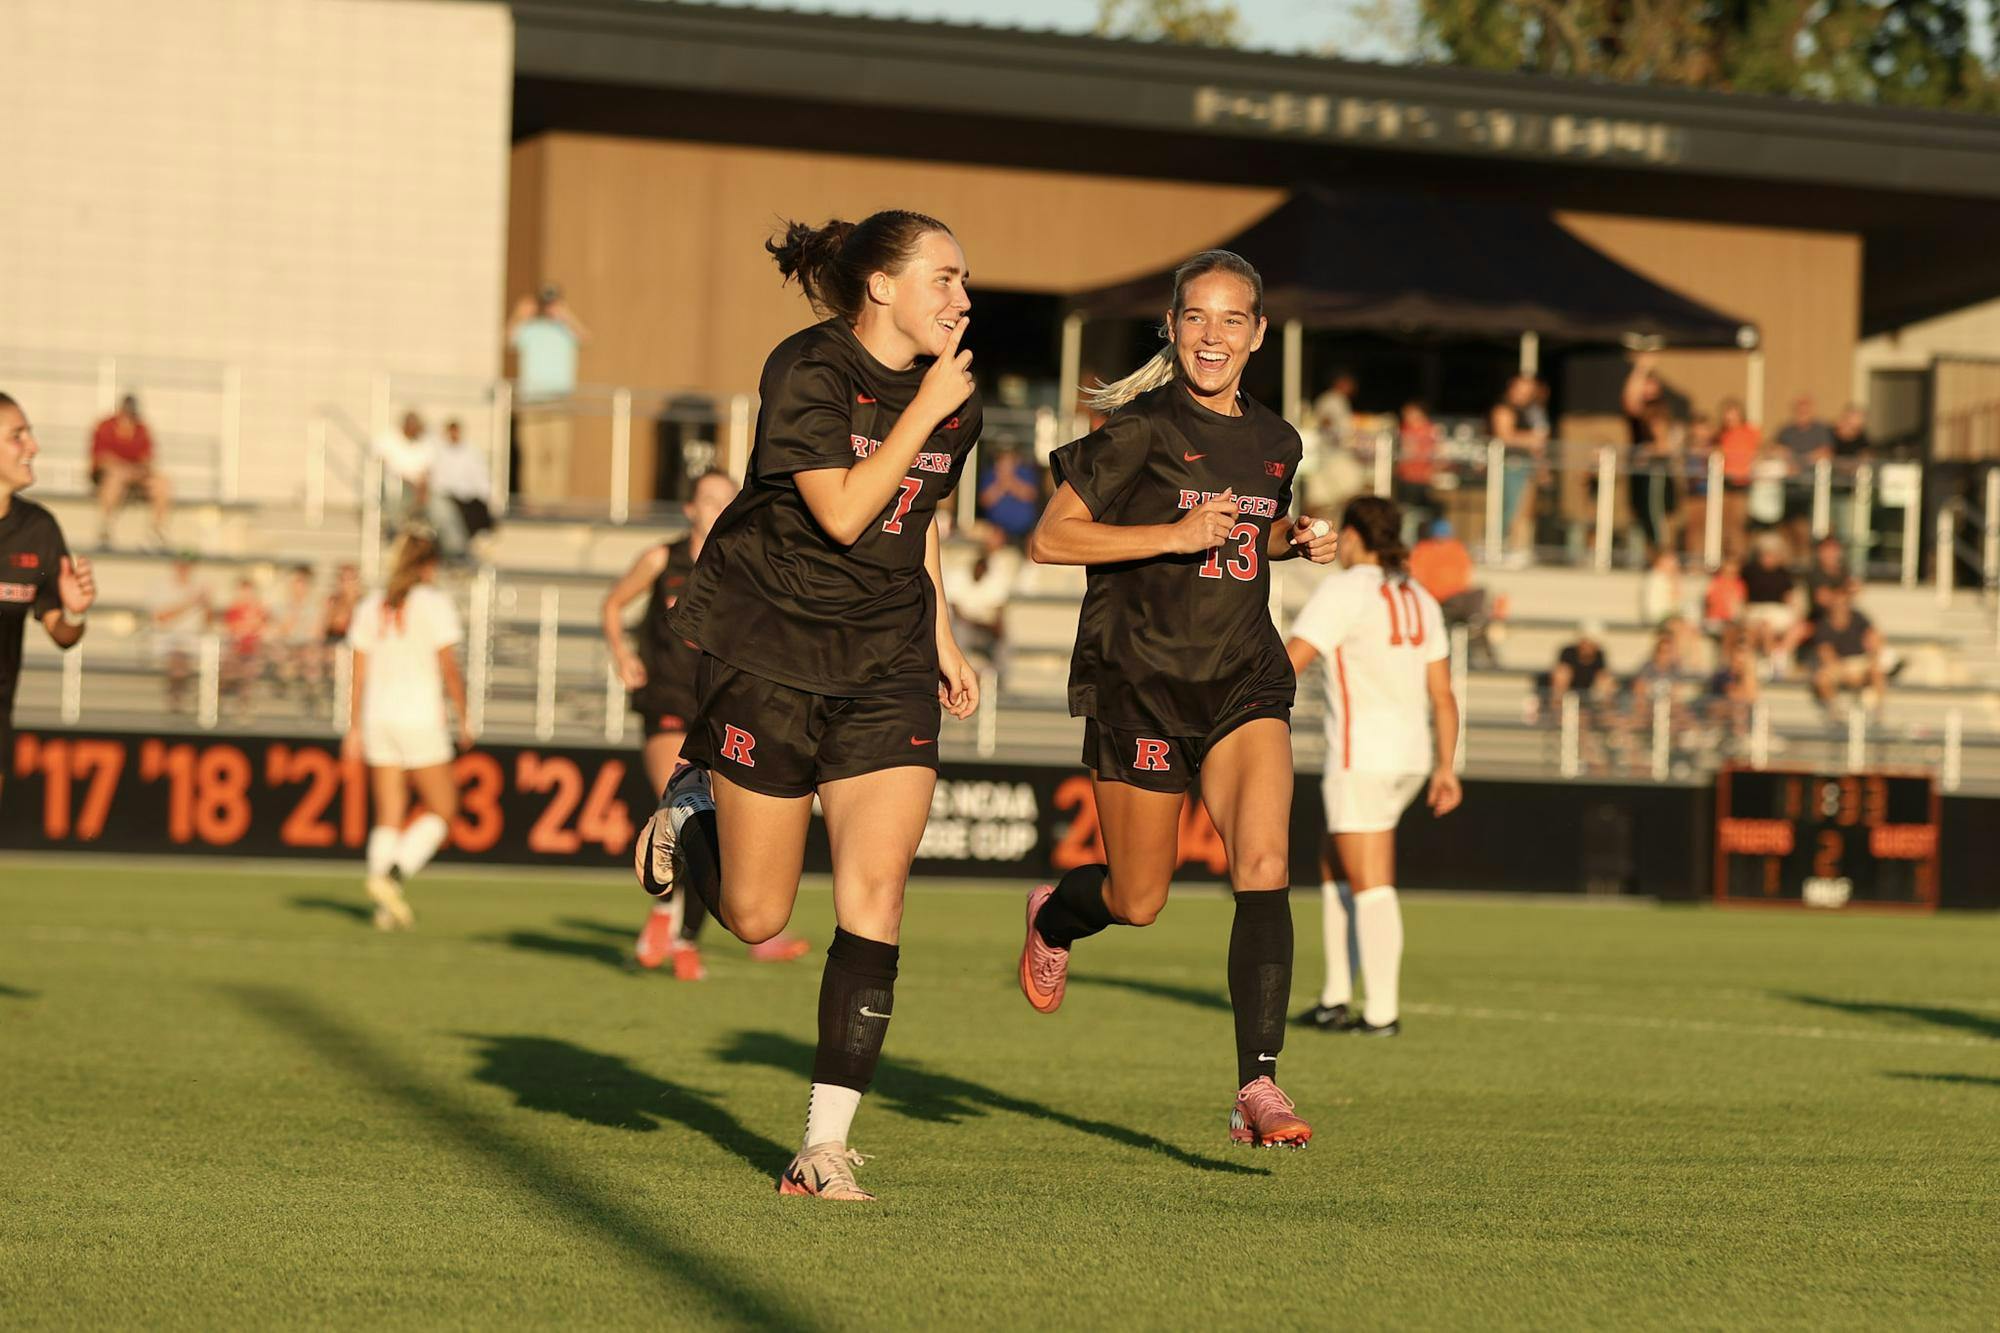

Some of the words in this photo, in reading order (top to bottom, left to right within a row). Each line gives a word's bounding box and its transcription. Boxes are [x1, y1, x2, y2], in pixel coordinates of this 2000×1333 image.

[882, 476, 923, 534] 7
[1199, 522, 1260, 581] 13
[1380, 582, 1424, 646] 10
[721, 723, 756, 767] R
[1133, 738, 1170, 770] R
[15, 734, 126, 841] '17
[140, 738, 252, 846] '18
[516, 751, 635, 856] '24
